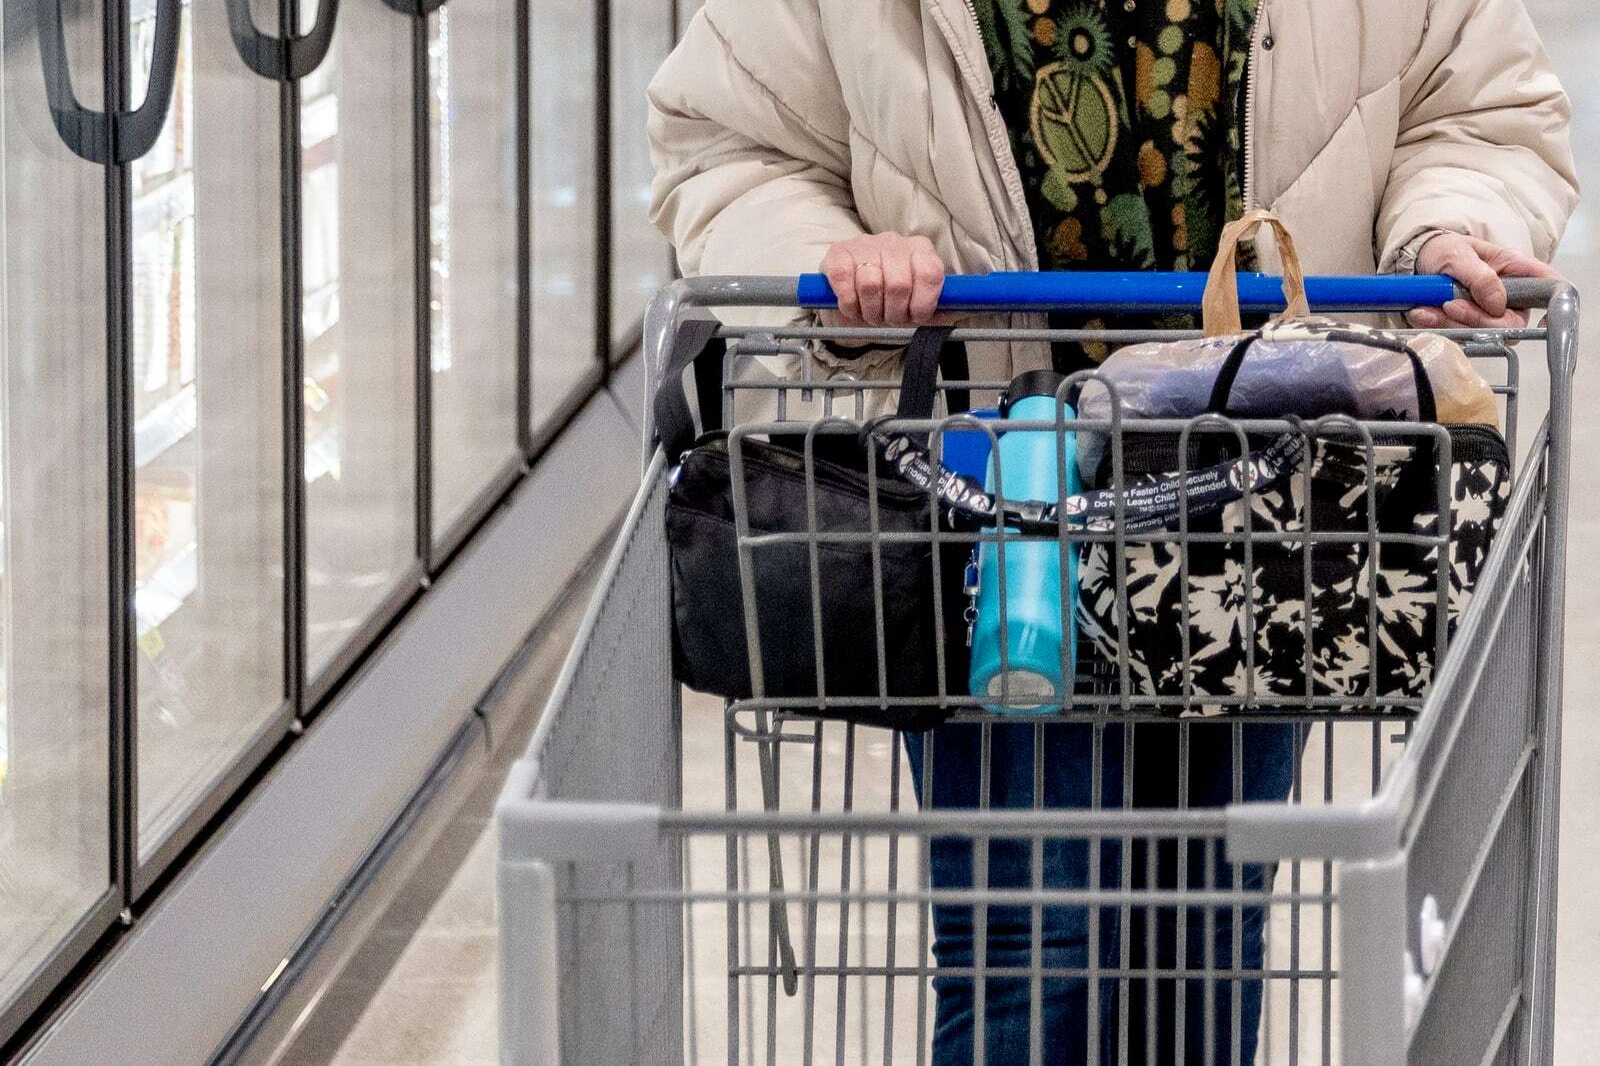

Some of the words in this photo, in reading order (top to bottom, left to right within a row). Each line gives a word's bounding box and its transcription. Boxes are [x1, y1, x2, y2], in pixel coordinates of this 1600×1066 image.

[1095, 500, 1107, 508] Do
[1127, 498, 1153, 506] Leave
[1154, 492, 1176, 503] Child
[1177, 479, 1227, 496] attended
[1100, 491, 1129, 499] Plee
[1131, 487, 1159, 498] Fasten
[1161, 479, 1180, 492] Child
[1182, 471, 1218, 485] ecurely
